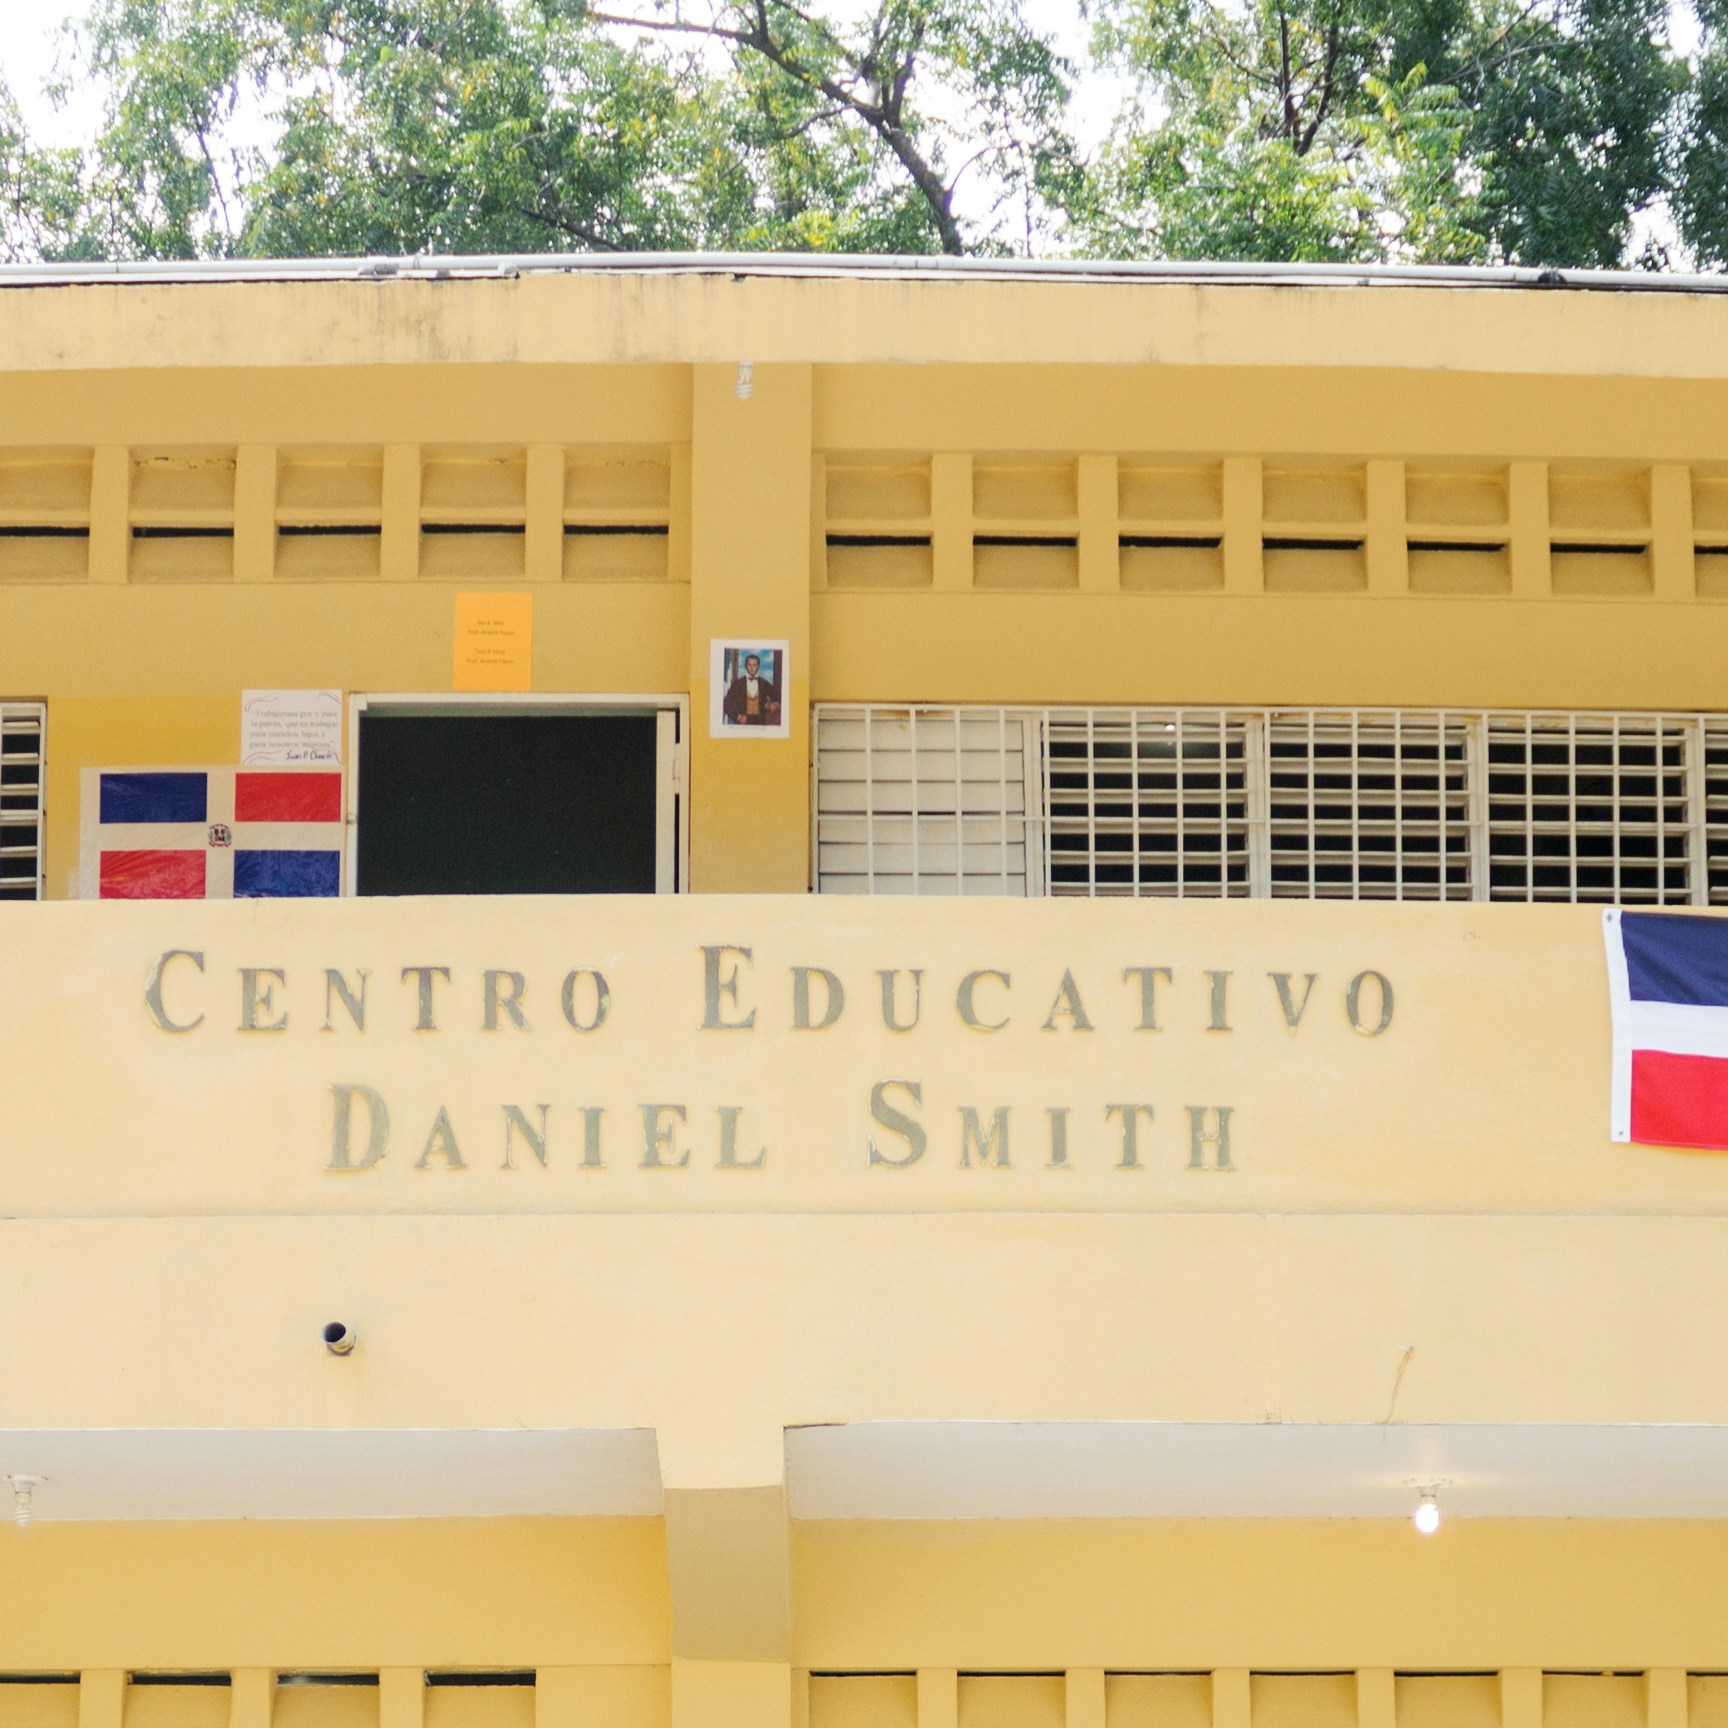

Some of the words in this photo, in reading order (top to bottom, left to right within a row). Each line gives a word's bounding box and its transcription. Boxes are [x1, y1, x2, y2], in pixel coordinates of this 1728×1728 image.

[144, 947, 613, 1038] CENTRO
[697, 943, 1399, 1039] EDUCATIVO
[323, 1080, 769, 1175] DANIEL
[866, 1076, 1239, 1177] SMITH
